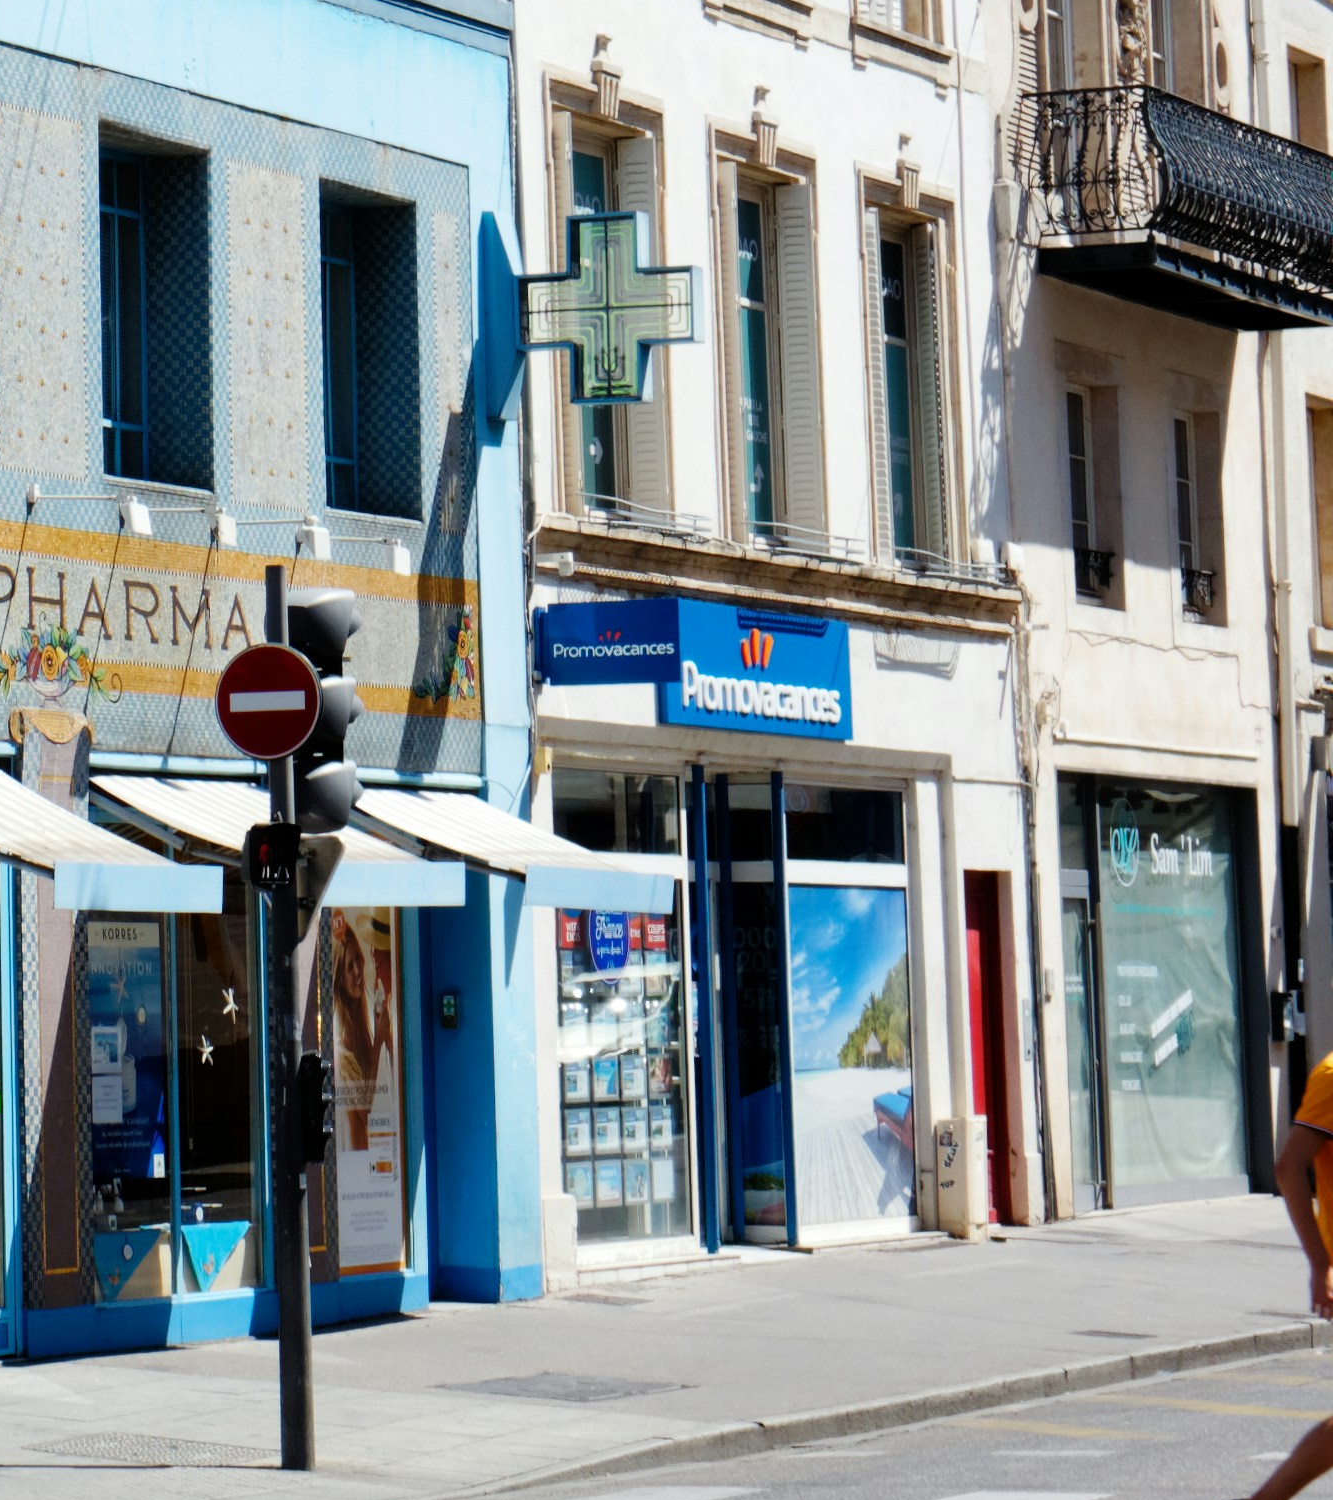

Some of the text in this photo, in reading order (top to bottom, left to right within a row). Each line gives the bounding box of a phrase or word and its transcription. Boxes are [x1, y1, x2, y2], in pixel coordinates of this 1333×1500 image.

[553, 641, 675, 659] Promovacances
[683, 660, 842, 725] Promovacances
[102, 927, 138, 941] KORRES
